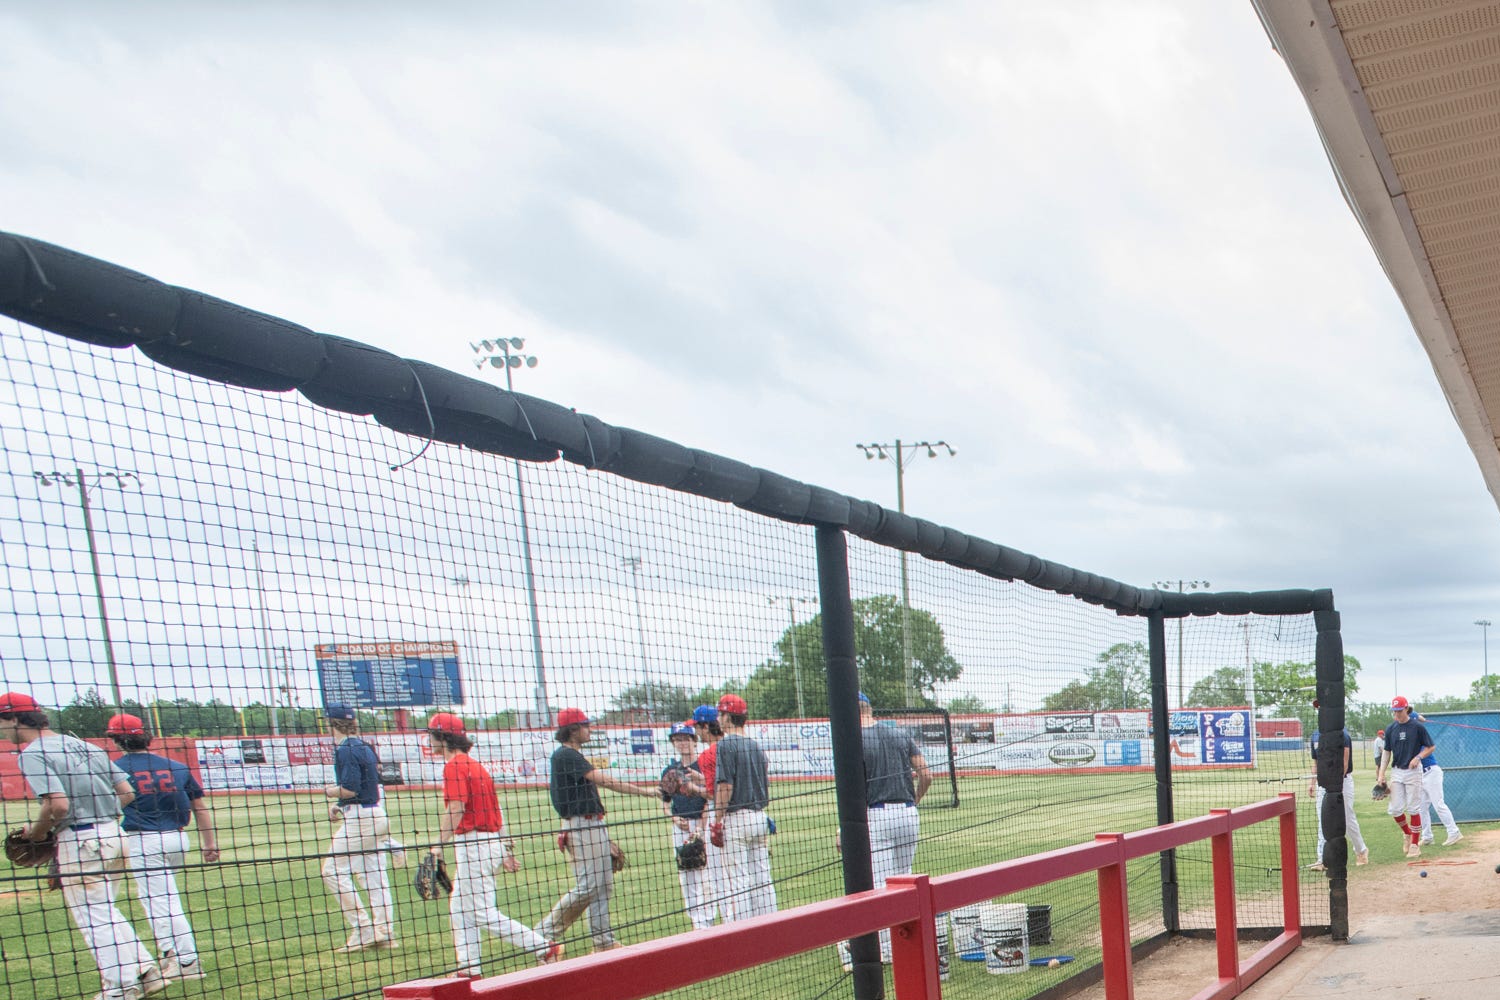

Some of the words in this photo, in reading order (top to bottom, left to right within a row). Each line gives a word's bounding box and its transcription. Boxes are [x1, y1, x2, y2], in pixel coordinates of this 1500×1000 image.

[342, 644, 376, 654] BOARD
[378, 644, 391, 653] OF
[393, 643, 454, 653] CHAMPIONS
[1203, 714, 1216, 762] PACE
[134, 769, 177, 795] 22
